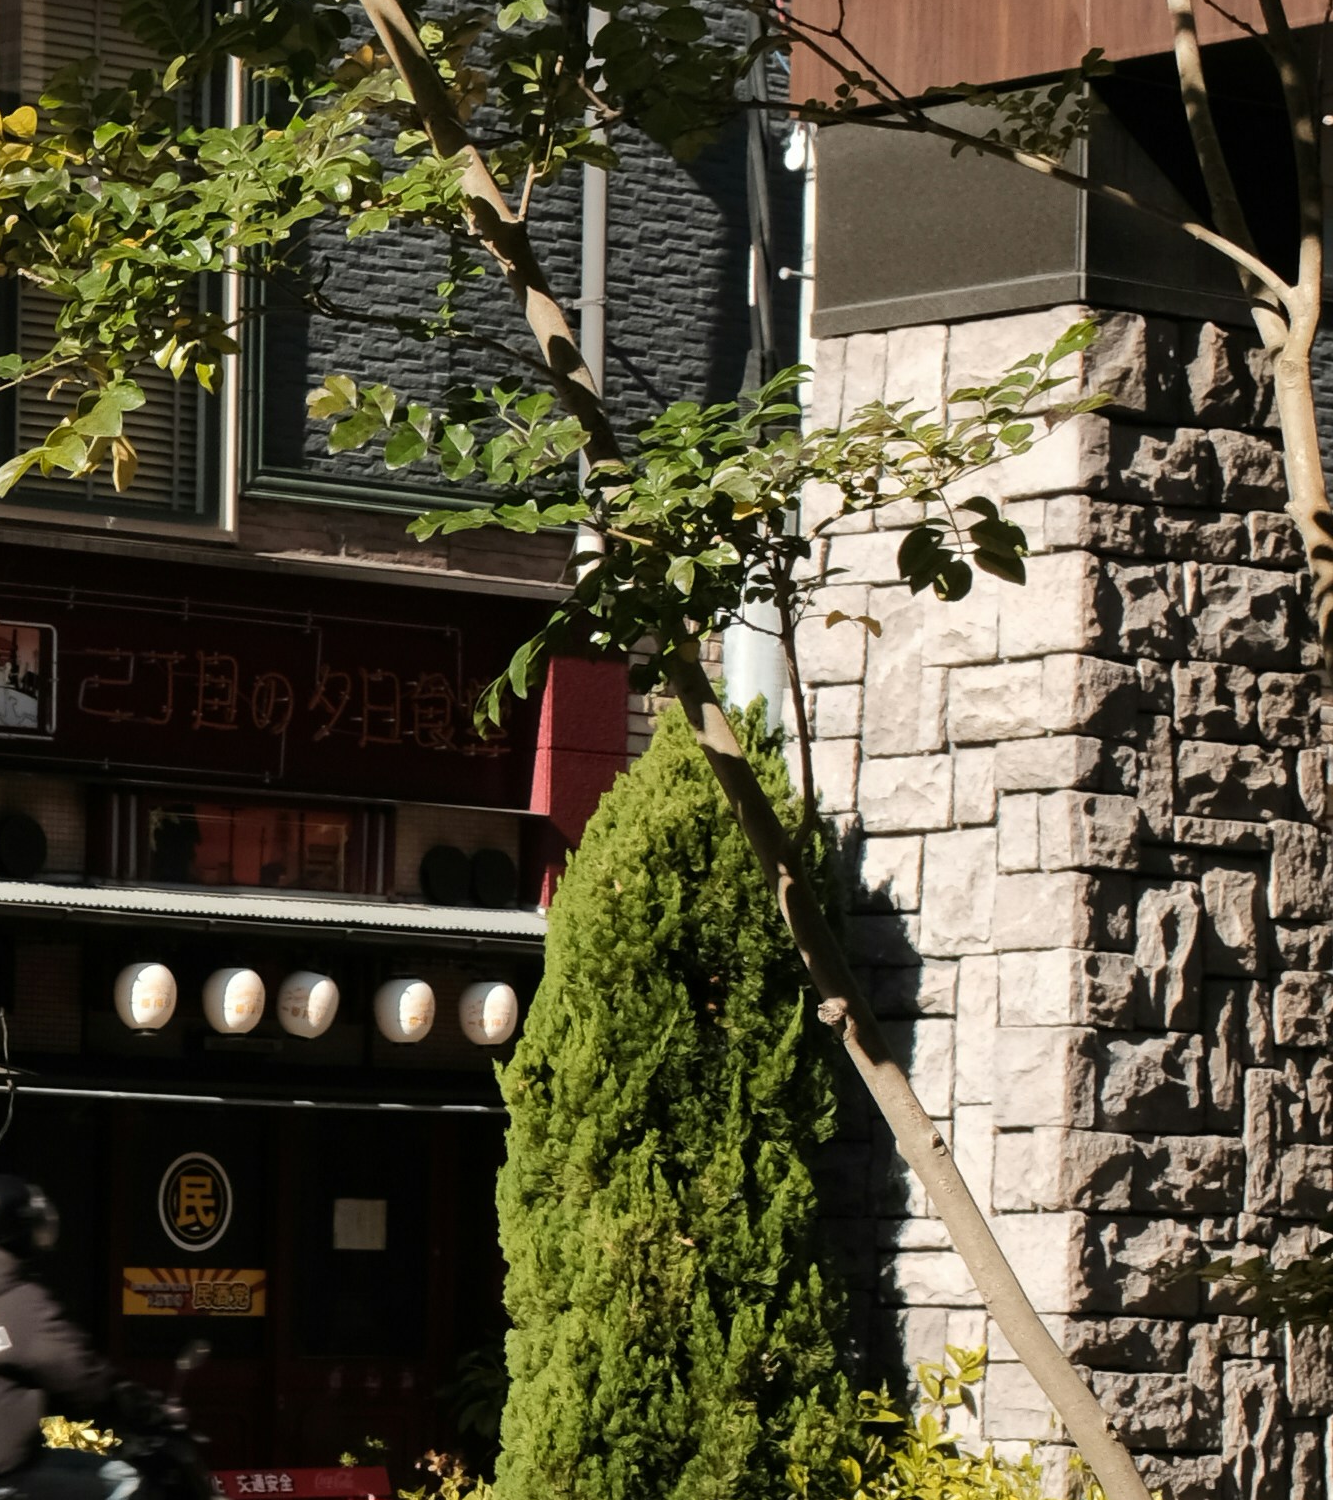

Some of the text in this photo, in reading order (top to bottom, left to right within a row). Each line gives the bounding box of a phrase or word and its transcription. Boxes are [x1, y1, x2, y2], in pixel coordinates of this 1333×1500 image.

[177, 1175, 217, 1227] 民
[193, 1282, 250, 1309] 民酒党
[236, 1474, 294, 1493] 交通安全
